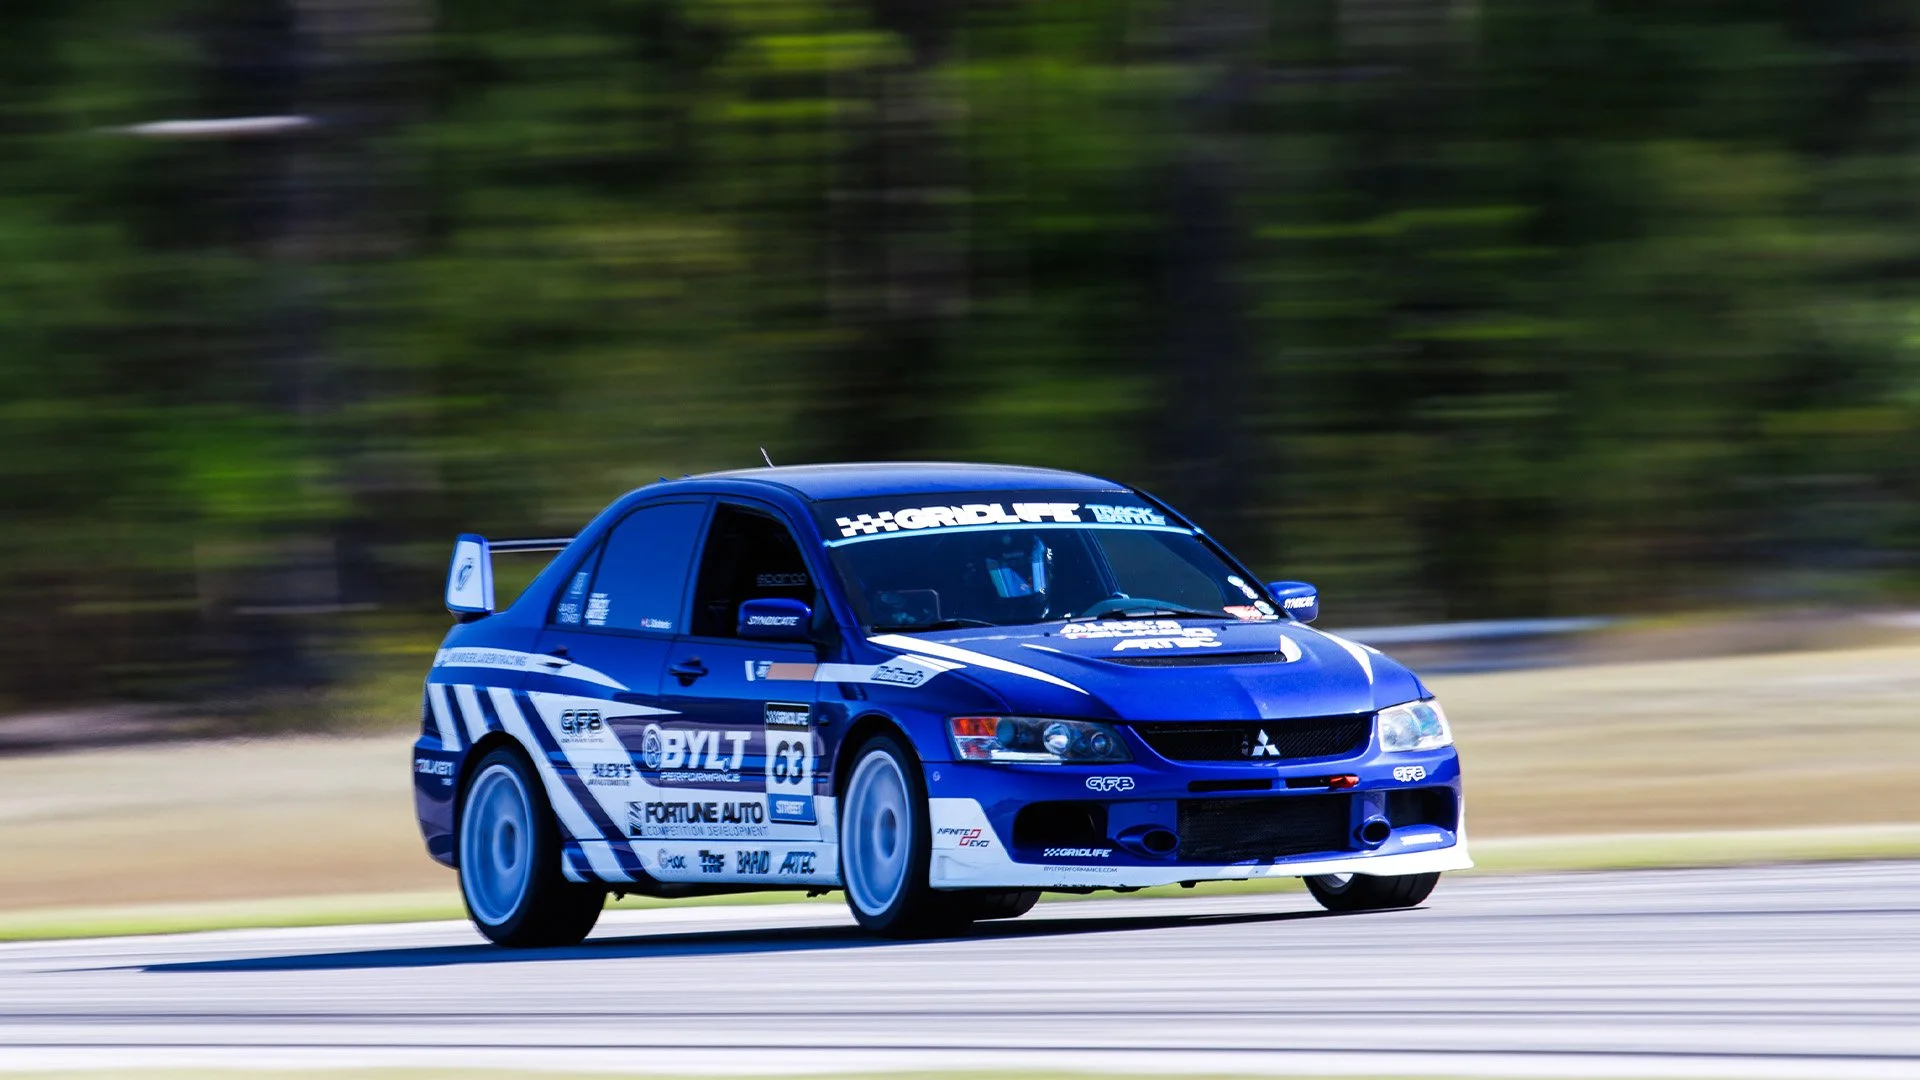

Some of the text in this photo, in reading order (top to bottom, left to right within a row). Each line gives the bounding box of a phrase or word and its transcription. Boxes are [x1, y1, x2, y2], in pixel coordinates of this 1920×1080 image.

[893, 502, 1081, 530] GRIDLIFE
[1085, 503, 1154, 517] TRACK
[1096, 513, 1166, 526] BATTLE
[747, 615, 799, 627] SYNDICATE
[561, 709, 604, 737] GFB
[660, 729, 751, 770] BYLT
[772, 740, 805, 785] 63
[660, 772, 740, 783] PERFORMANCE
[1393, 766, 1426, 782] GFB
[1086, 776, 1135, 791] GFB
[645, 801, 764, 824] FORTUNE AUTO
[776, 800, 805, 815] STREET
[646, 826, 769, 837] COMPETITION DEVELOPMENT
[1059, 848, 1112, 858] GRIDLIFE
[736, 850, 771, 875] BRAID
[778, 851, 818, 876] ARTEC
[1044, 866, 1117, 874] BYLTPERFORMANCE.COM
